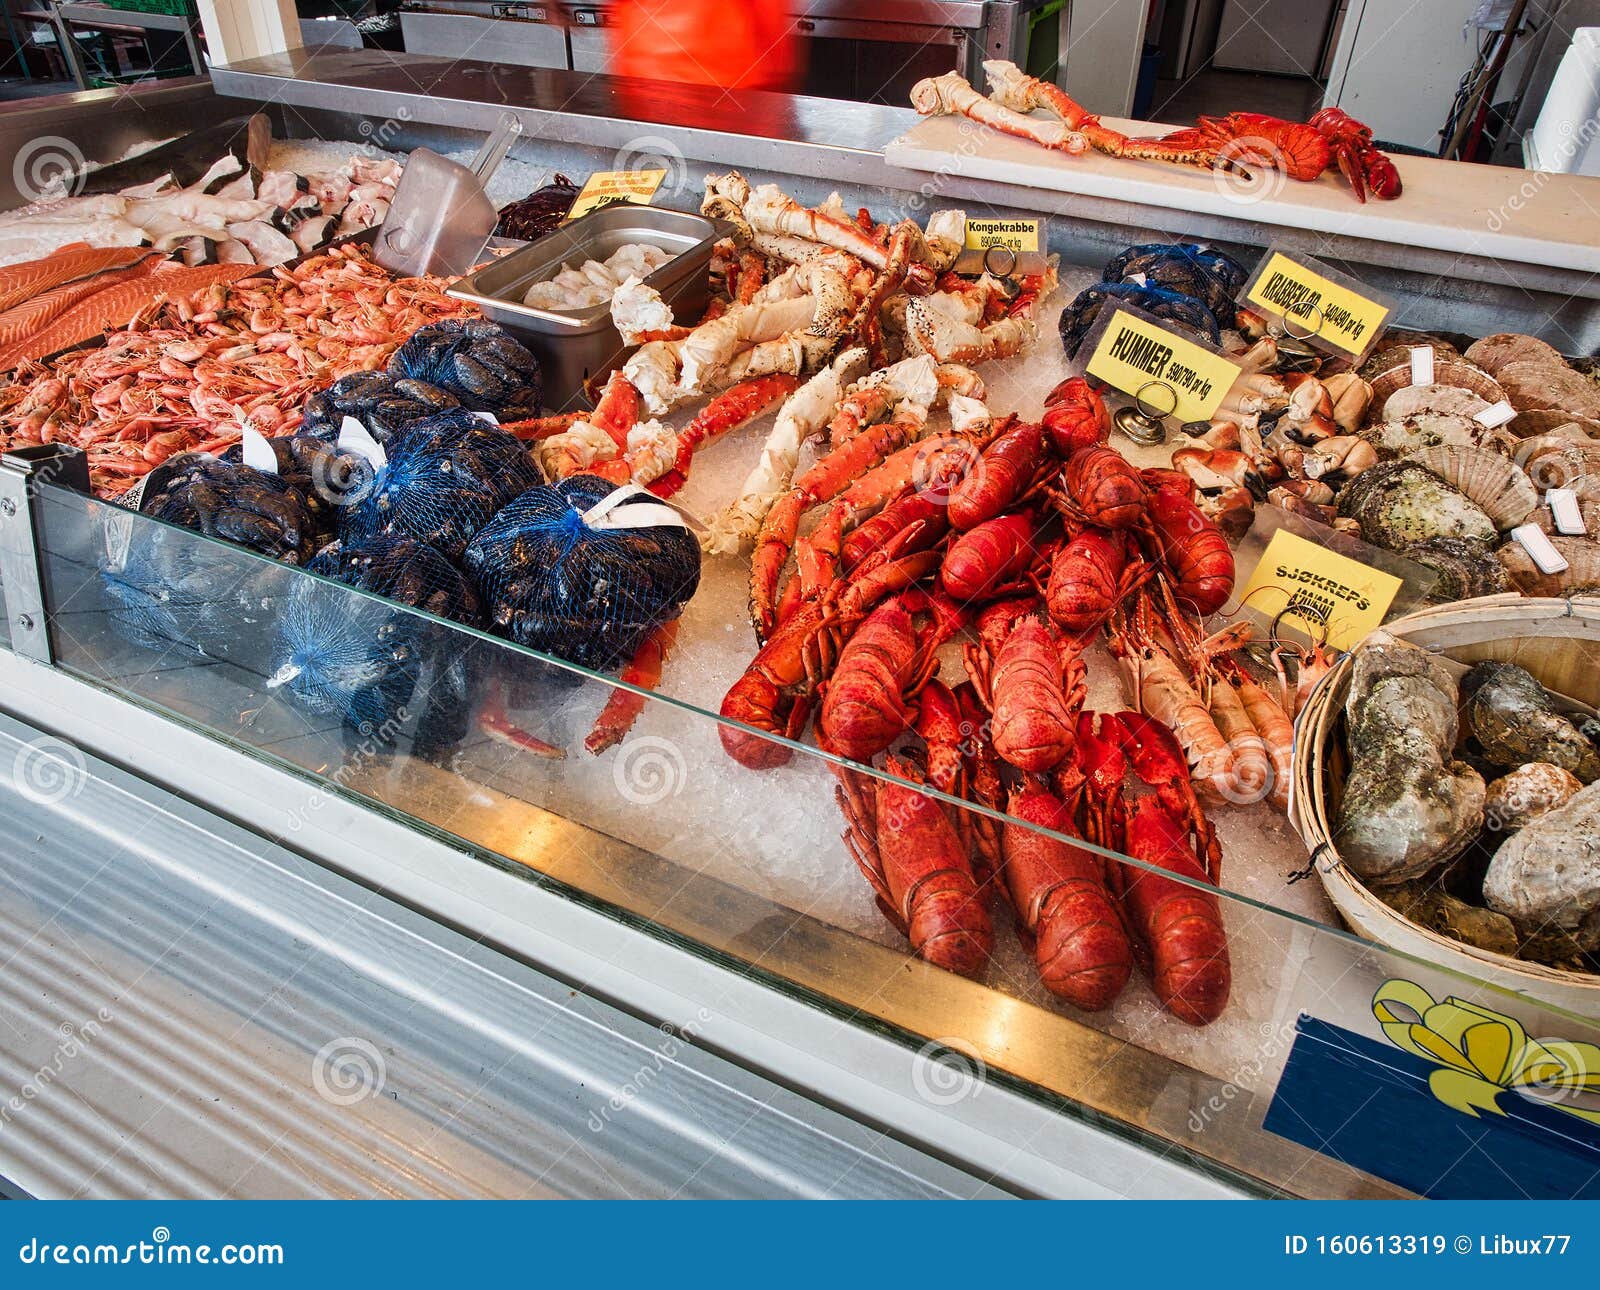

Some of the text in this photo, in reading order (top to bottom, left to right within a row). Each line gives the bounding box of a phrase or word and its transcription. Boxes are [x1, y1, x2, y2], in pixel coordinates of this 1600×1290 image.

[968, 222, 1034, 234] Kongekrabbe
[1014, 237, 1022, 251] kg
[1341, 318, 1356, 334] pr
[1352, 318, 1366, 340] kg
[1108, 327, 1213, 401] HUMMER 590/790 pr kg
[1275, 565, 1371, 610] SJØKREPS
